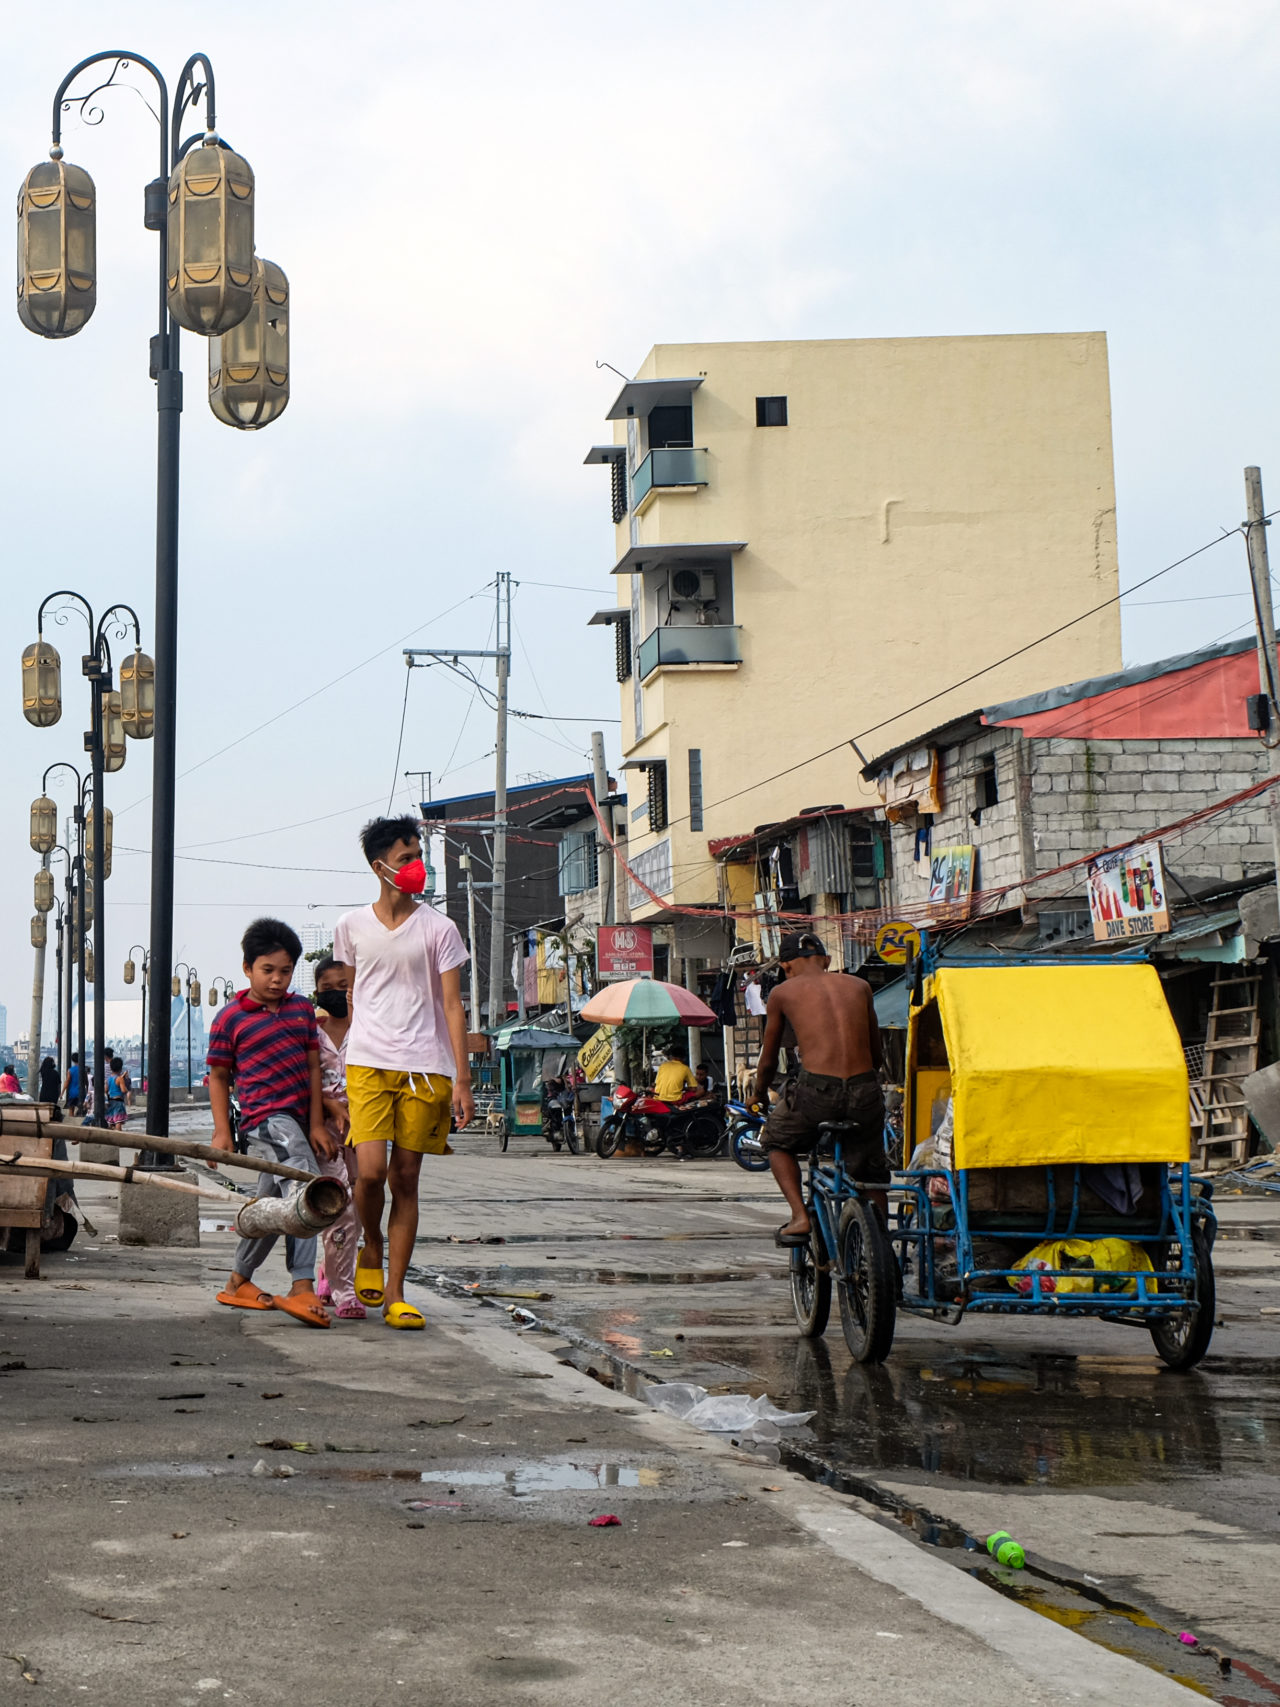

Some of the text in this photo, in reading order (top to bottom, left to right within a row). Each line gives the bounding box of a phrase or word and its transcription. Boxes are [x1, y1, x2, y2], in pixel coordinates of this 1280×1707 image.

[930, 855, 947, 891] RC
[1106, 915, 1154, 938] DAVE STORE
[615, 930, 634, 949] MS
[879, 928, 916, 952] RC
